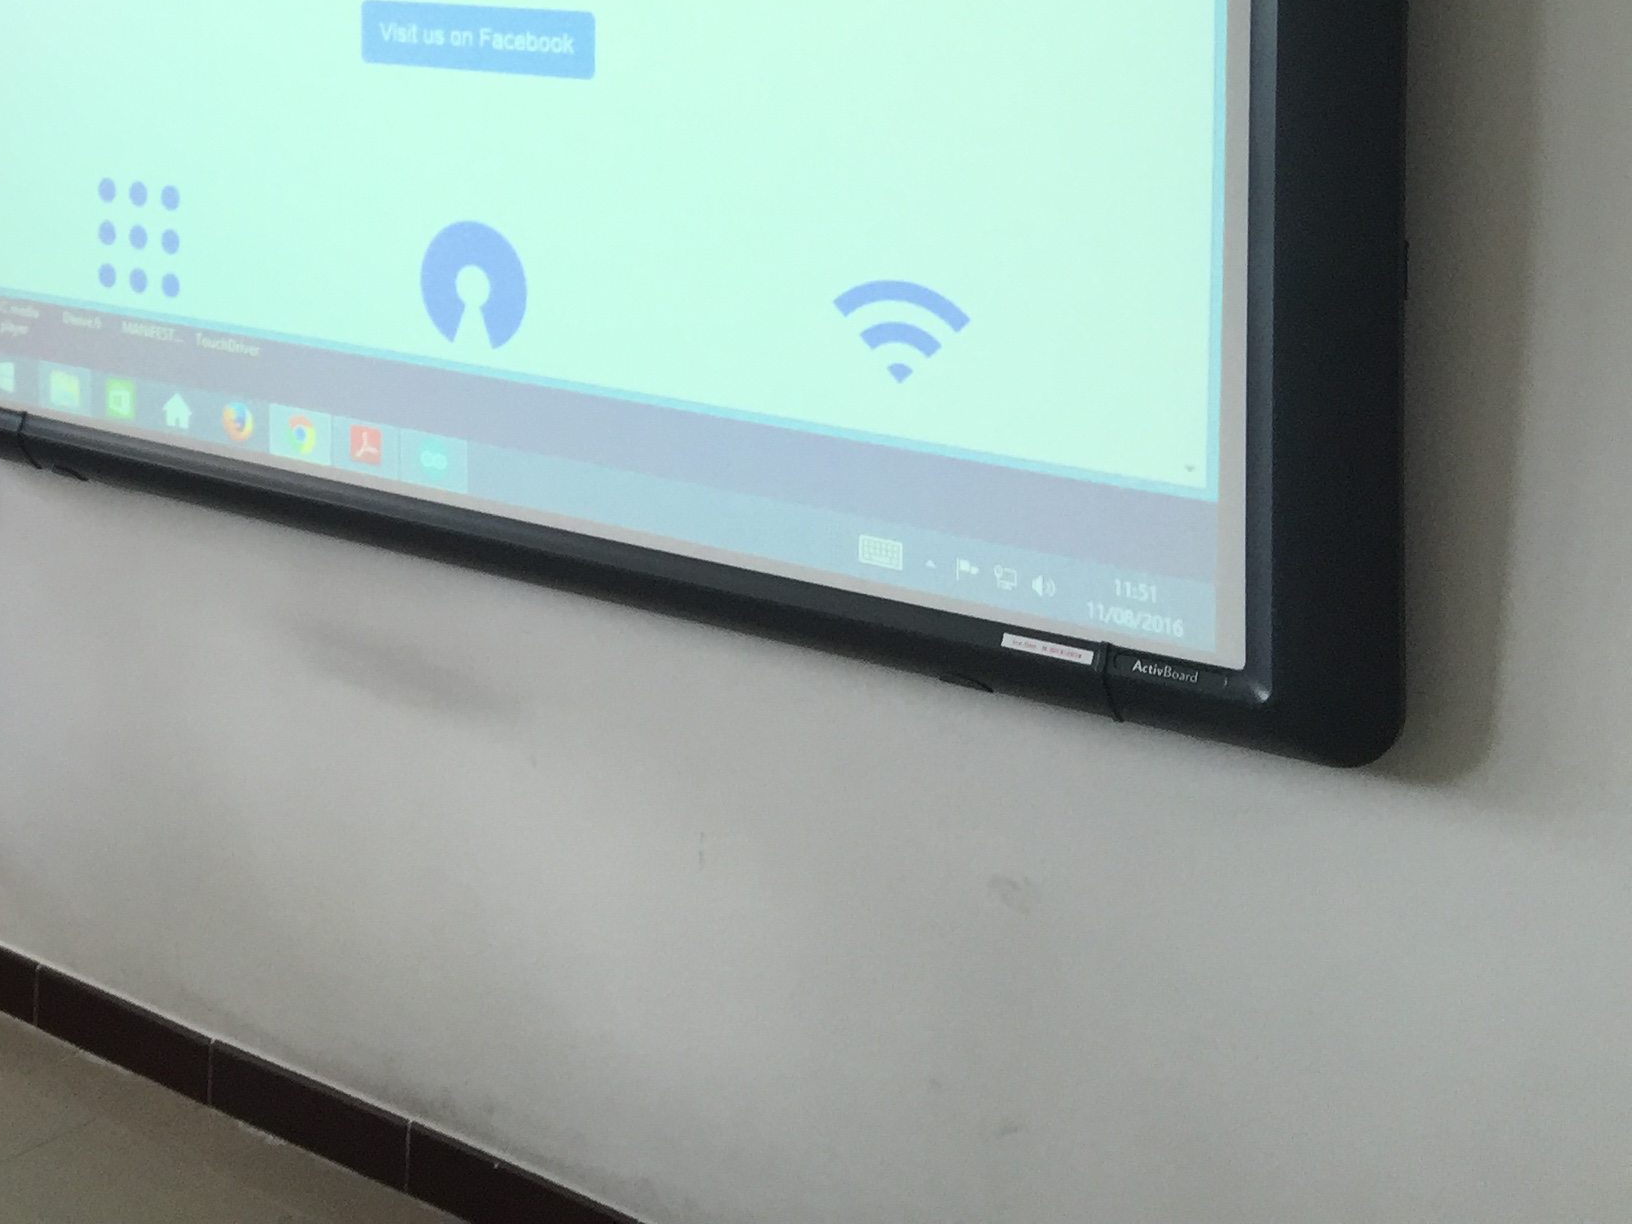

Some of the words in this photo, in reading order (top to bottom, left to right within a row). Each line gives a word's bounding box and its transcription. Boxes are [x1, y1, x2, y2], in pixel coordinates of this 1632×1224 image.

[379, 22, 418, 43] Visit
[423, 28, 445, 45] us
[450, 30, 474, 47] on
[479, 27, 575, 55] Facebook
[195, 332, 260, 357] TouchDriver
[1115, 578, 1157, 604] 11:51
[1087, 601, 1184, 637] 11/08/2016
[1132, 659, 1199, 683] ActivBoard
